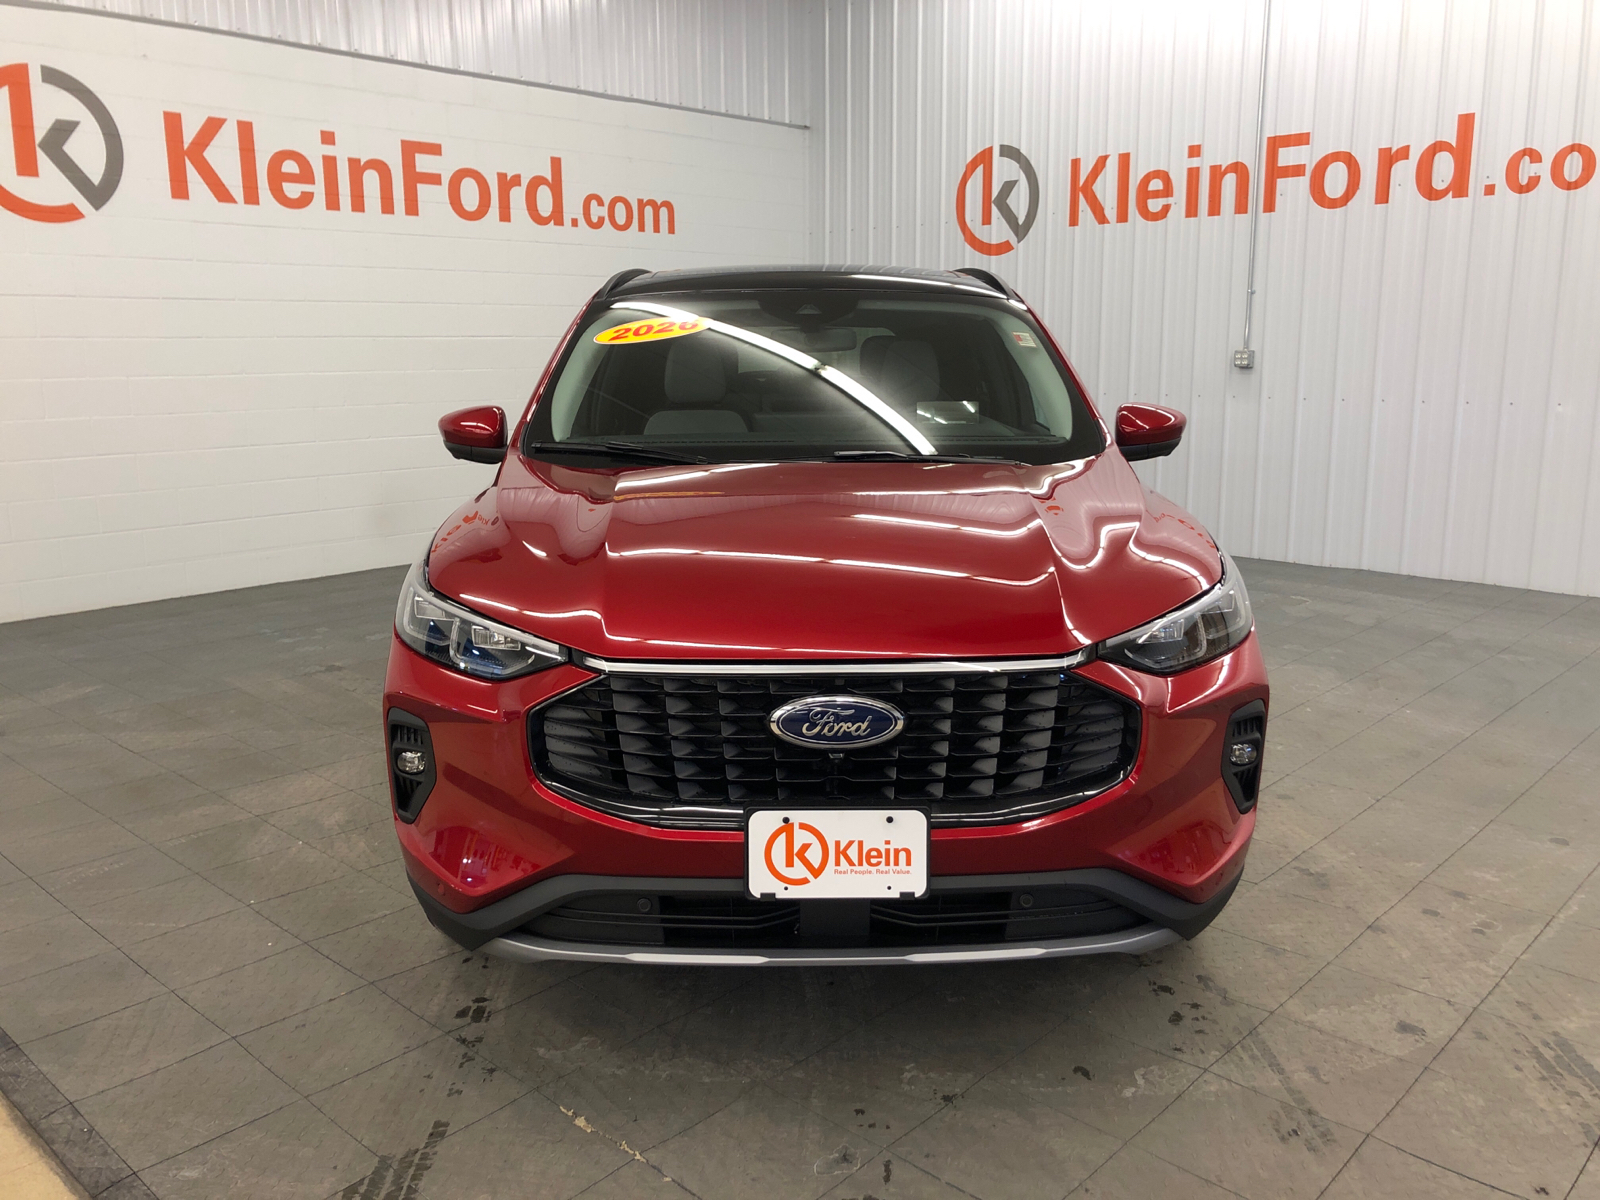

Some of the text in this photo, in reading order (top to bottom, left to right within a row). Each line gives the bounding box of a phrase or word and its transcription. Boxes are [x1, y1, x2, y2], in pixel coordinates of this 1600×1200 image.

[163, 111, 676, 235] KleinFord.com
[802, 708, 872, 736] Ford
[834, 840, 912, 867] Klein
